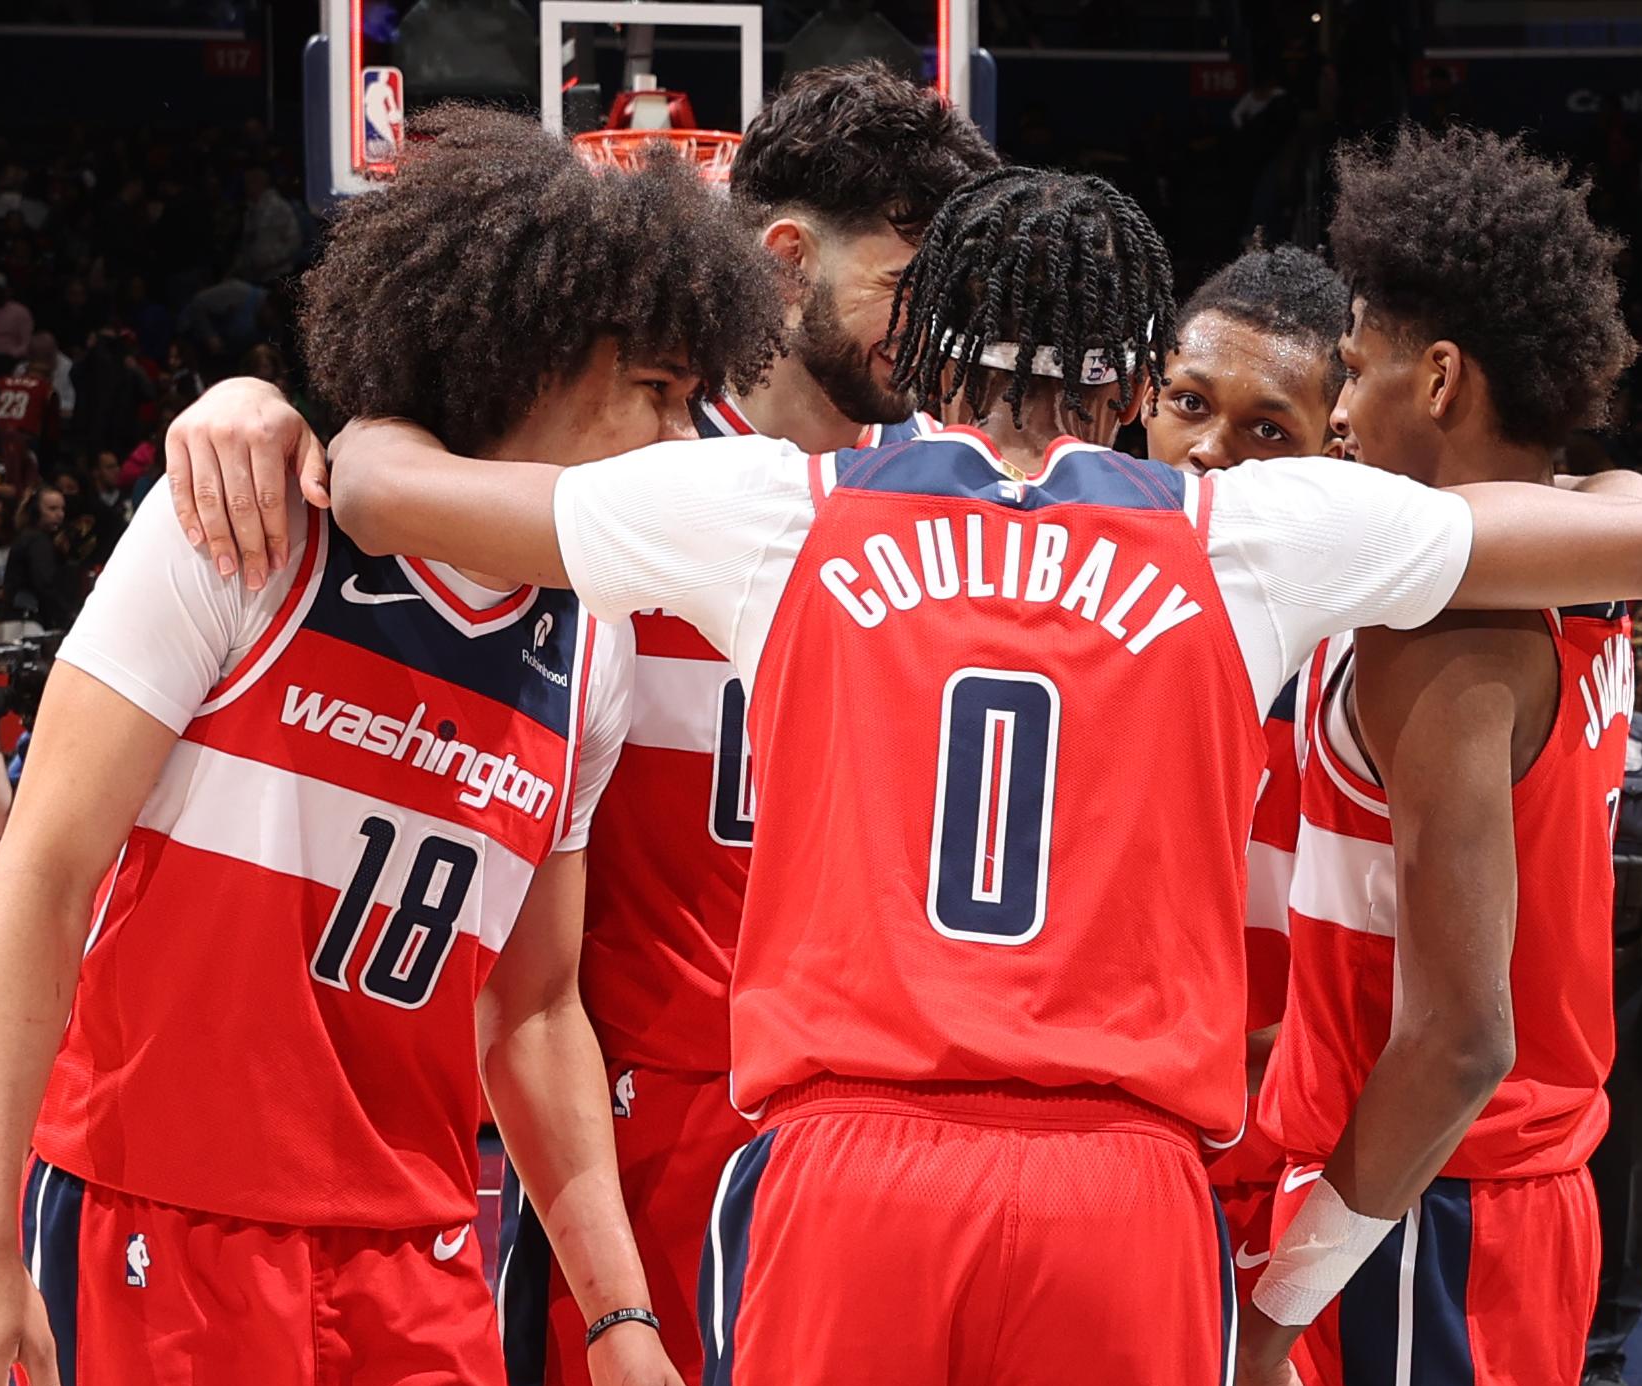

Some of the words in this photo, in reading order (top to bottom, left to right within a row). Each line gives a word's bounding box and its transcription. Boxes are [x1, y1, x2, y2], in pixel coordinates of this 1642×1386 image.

[213, 46, 251, 71] 117
[819, 514, 1202, 656] COULIBALY
[522, 648, 568, 687] Robinhood
[279, 684, 555, 820] washington
[926, 666, 1061, 946] 0
[309, 811, 483, 1010] 18
